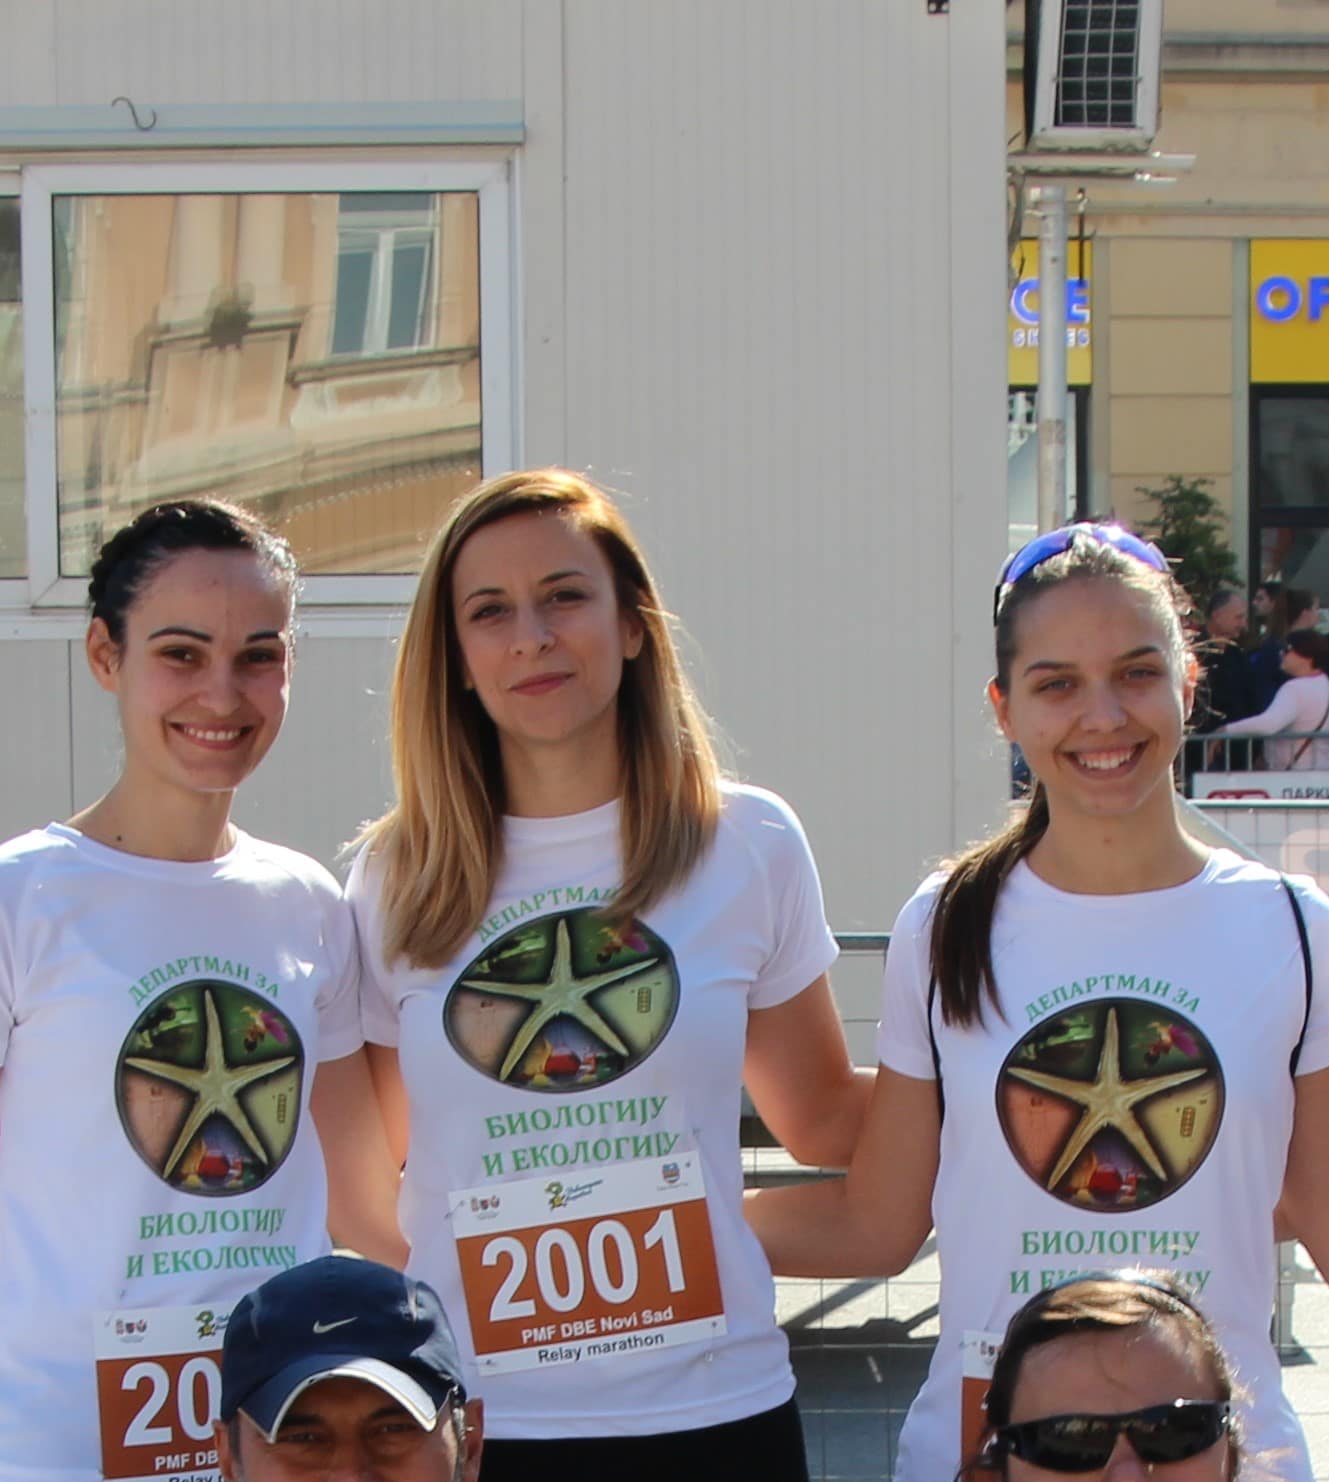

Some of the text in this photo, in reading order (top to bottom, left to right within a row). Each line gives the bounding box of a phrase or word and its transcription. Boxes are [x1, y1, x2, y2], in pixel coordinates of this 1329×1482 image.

[128, 955, 280, 1007] ДЕПАРТМАН ЗА
[1025, 974, 1201, 1023] ДЕПАРТМАН ЗА
[484, 1096, 668, 1140] БИОЛОГИЈУ
[482, 1131, 680, 1178] И ЕКОЛОГИЈУ
[139, 1207, 287, 1240] БИОЛОГИЈУ
[125, 1244, 296, 1280] И ЕКОЛОГИЈУ
[481, 1208, 686, 1323] 2001
[1021, 1230, 1201, 1261] БИОЛОГИЈУ
[1009, 1269, 1030, 1295] И
[522, 1305, 674, 1345] PMF DBE Novi Sad
[538, 1332, 665, 1365] Relay marathon
[121, 1356, 223, 1448] 20
[155, 1452, 219, 1472] PMF DB
